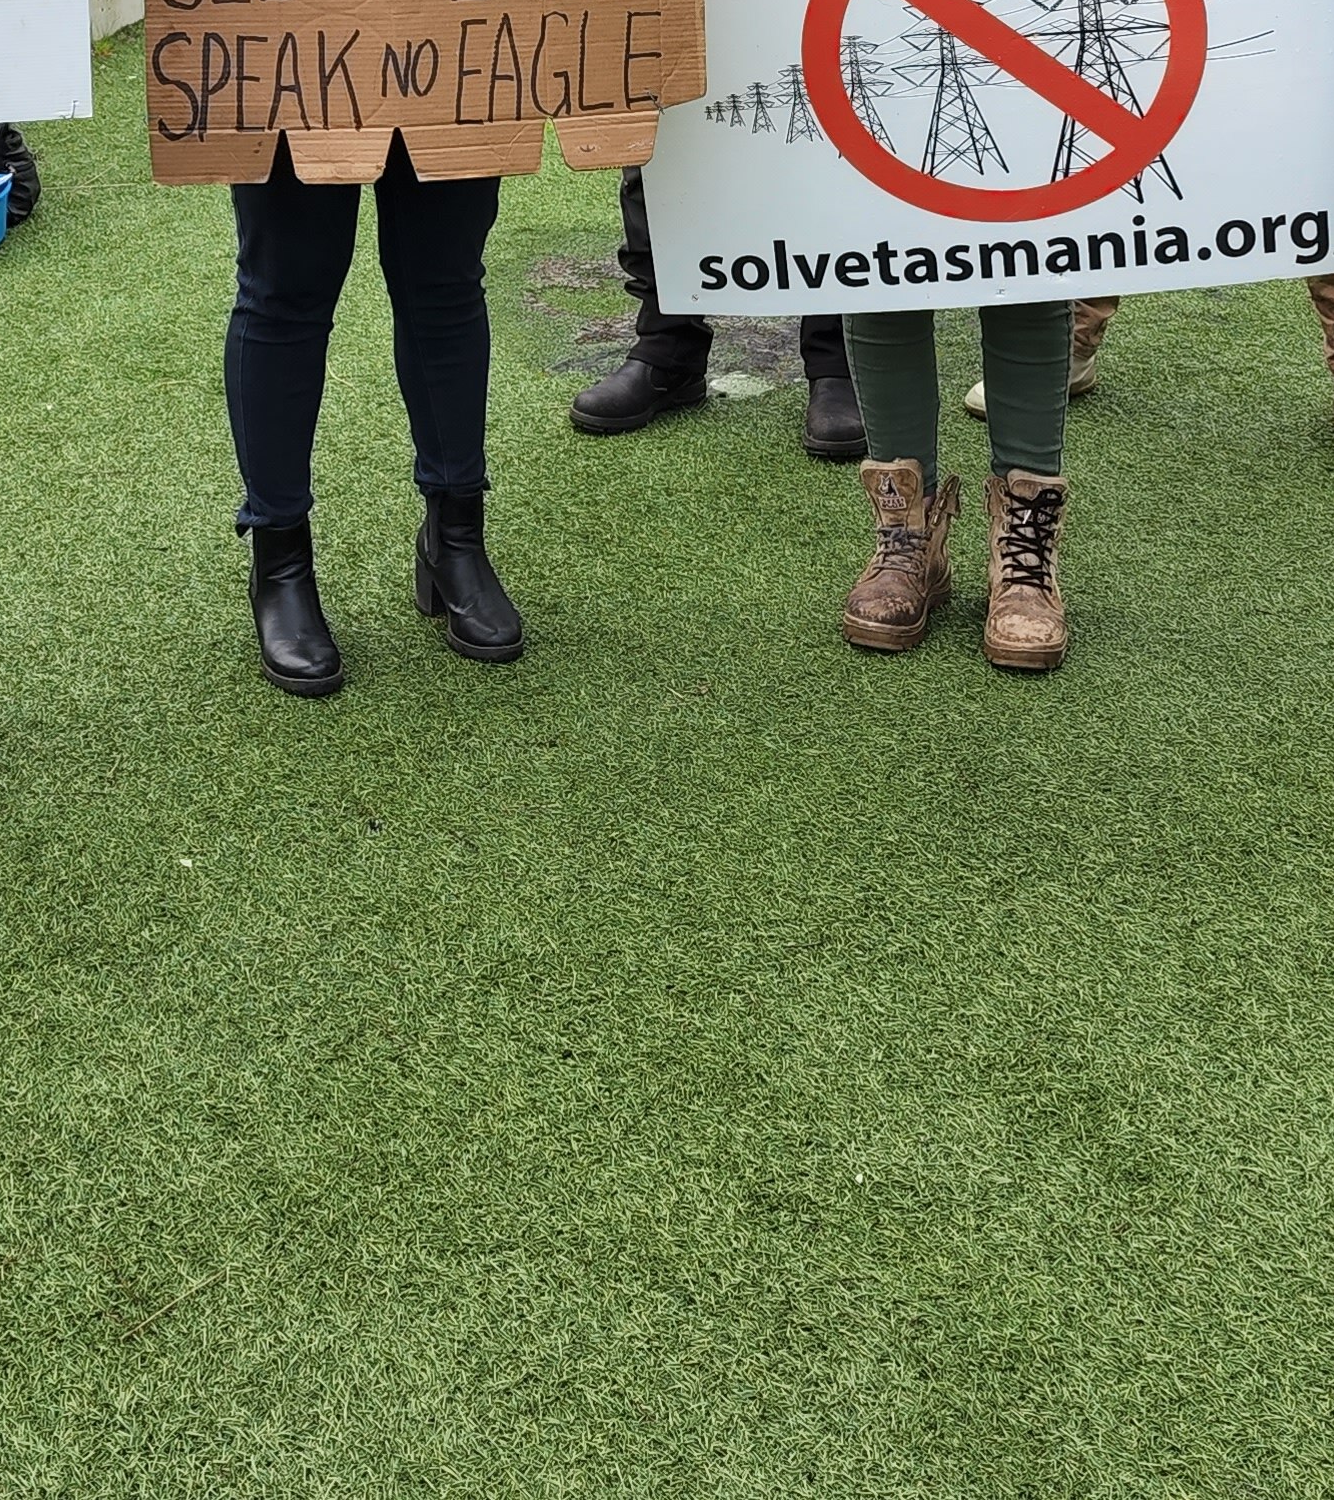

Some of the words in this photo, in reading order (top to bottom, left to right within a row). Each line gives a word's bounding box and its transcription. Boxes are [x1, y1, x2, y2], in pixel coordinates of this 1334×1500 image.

[151, 29, 363, 144] SPEAK
[380, 37, 440, 99] NO
[454, 10, 663, 126] EAGLE
[698, 209, 1332, 293] solvetasmania.org
